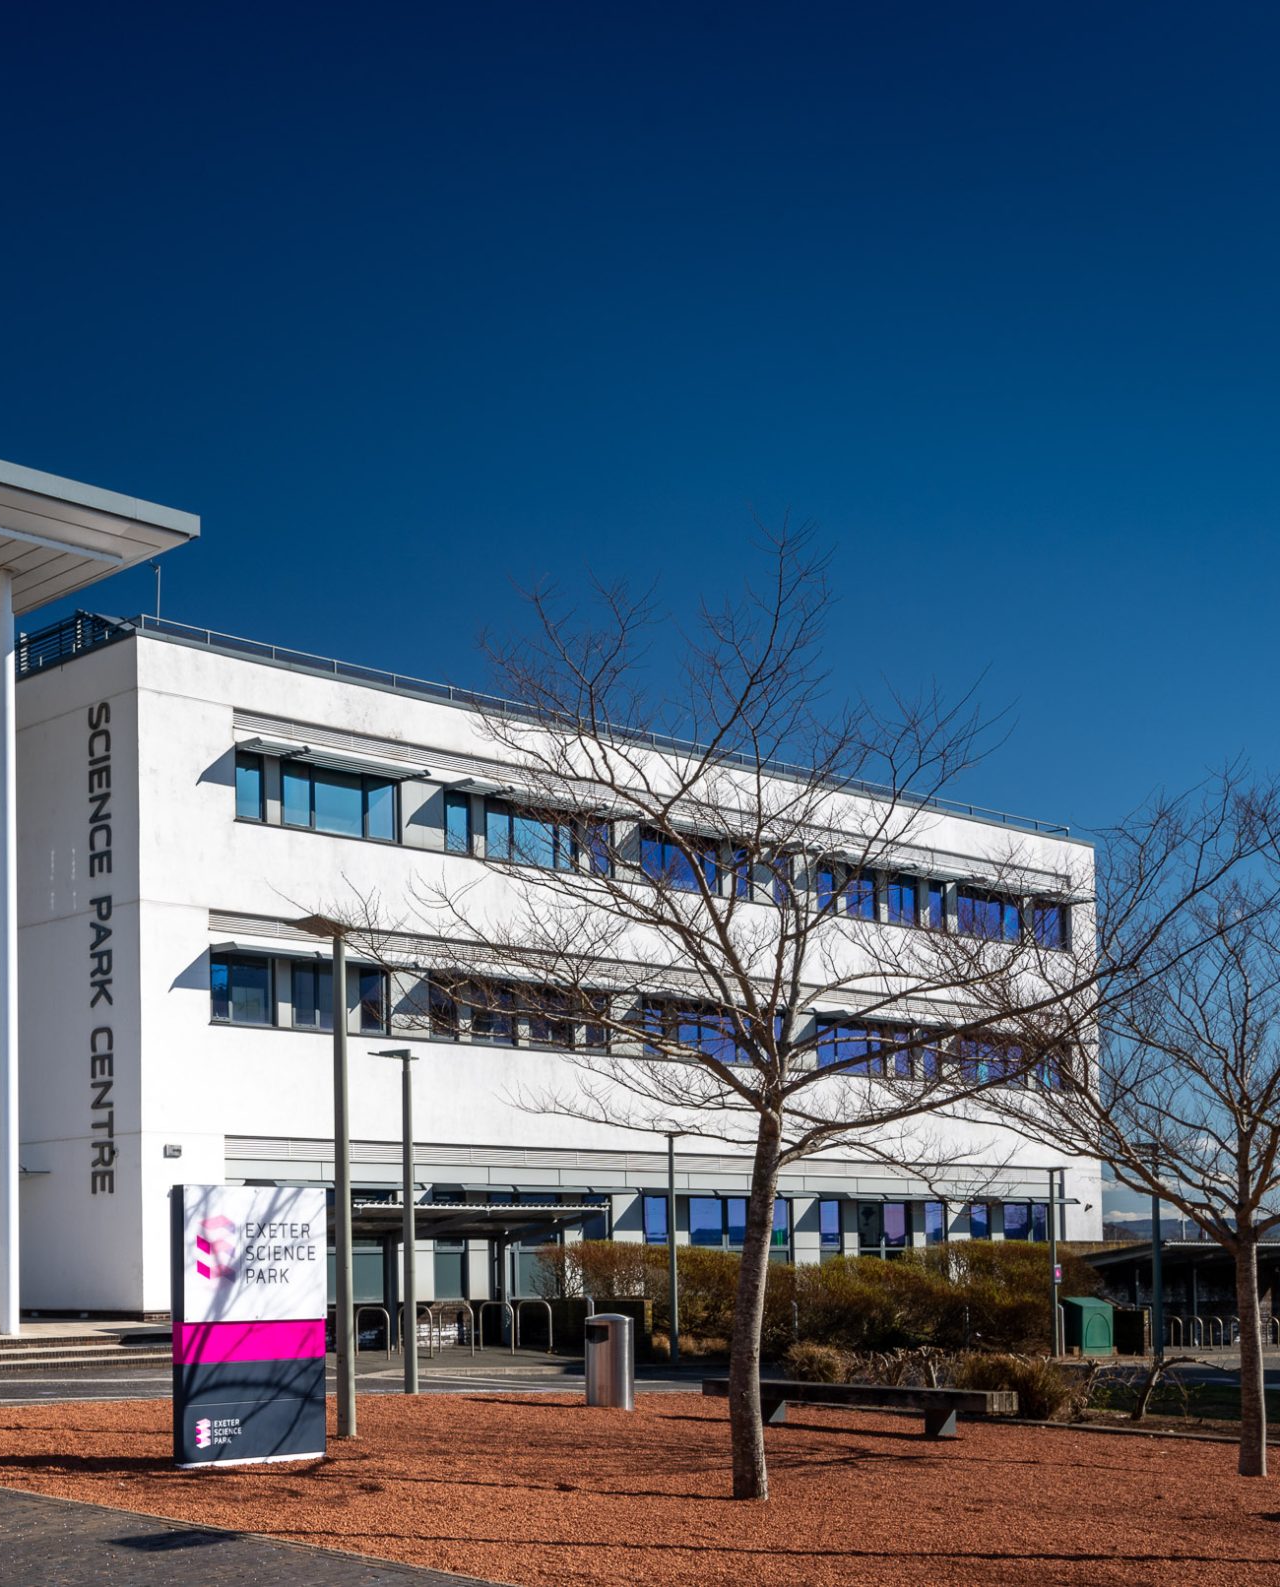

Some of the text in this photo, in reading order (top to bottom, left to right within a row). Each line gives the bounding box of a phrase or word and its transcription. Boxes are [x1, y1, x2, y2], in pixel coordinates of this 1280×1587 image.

[88, 702, 114, 1194] SCIENCE PARK CENTRE
[245, 1222, 310, 1239] EXETER
[245, 1245, 316, 1261] SCIENCE
[245, 1268, 289, 1284] PARK
[214, 1419, 240, 1427] EXETER
[214, 1427, 242, 1436] SCIENCE
